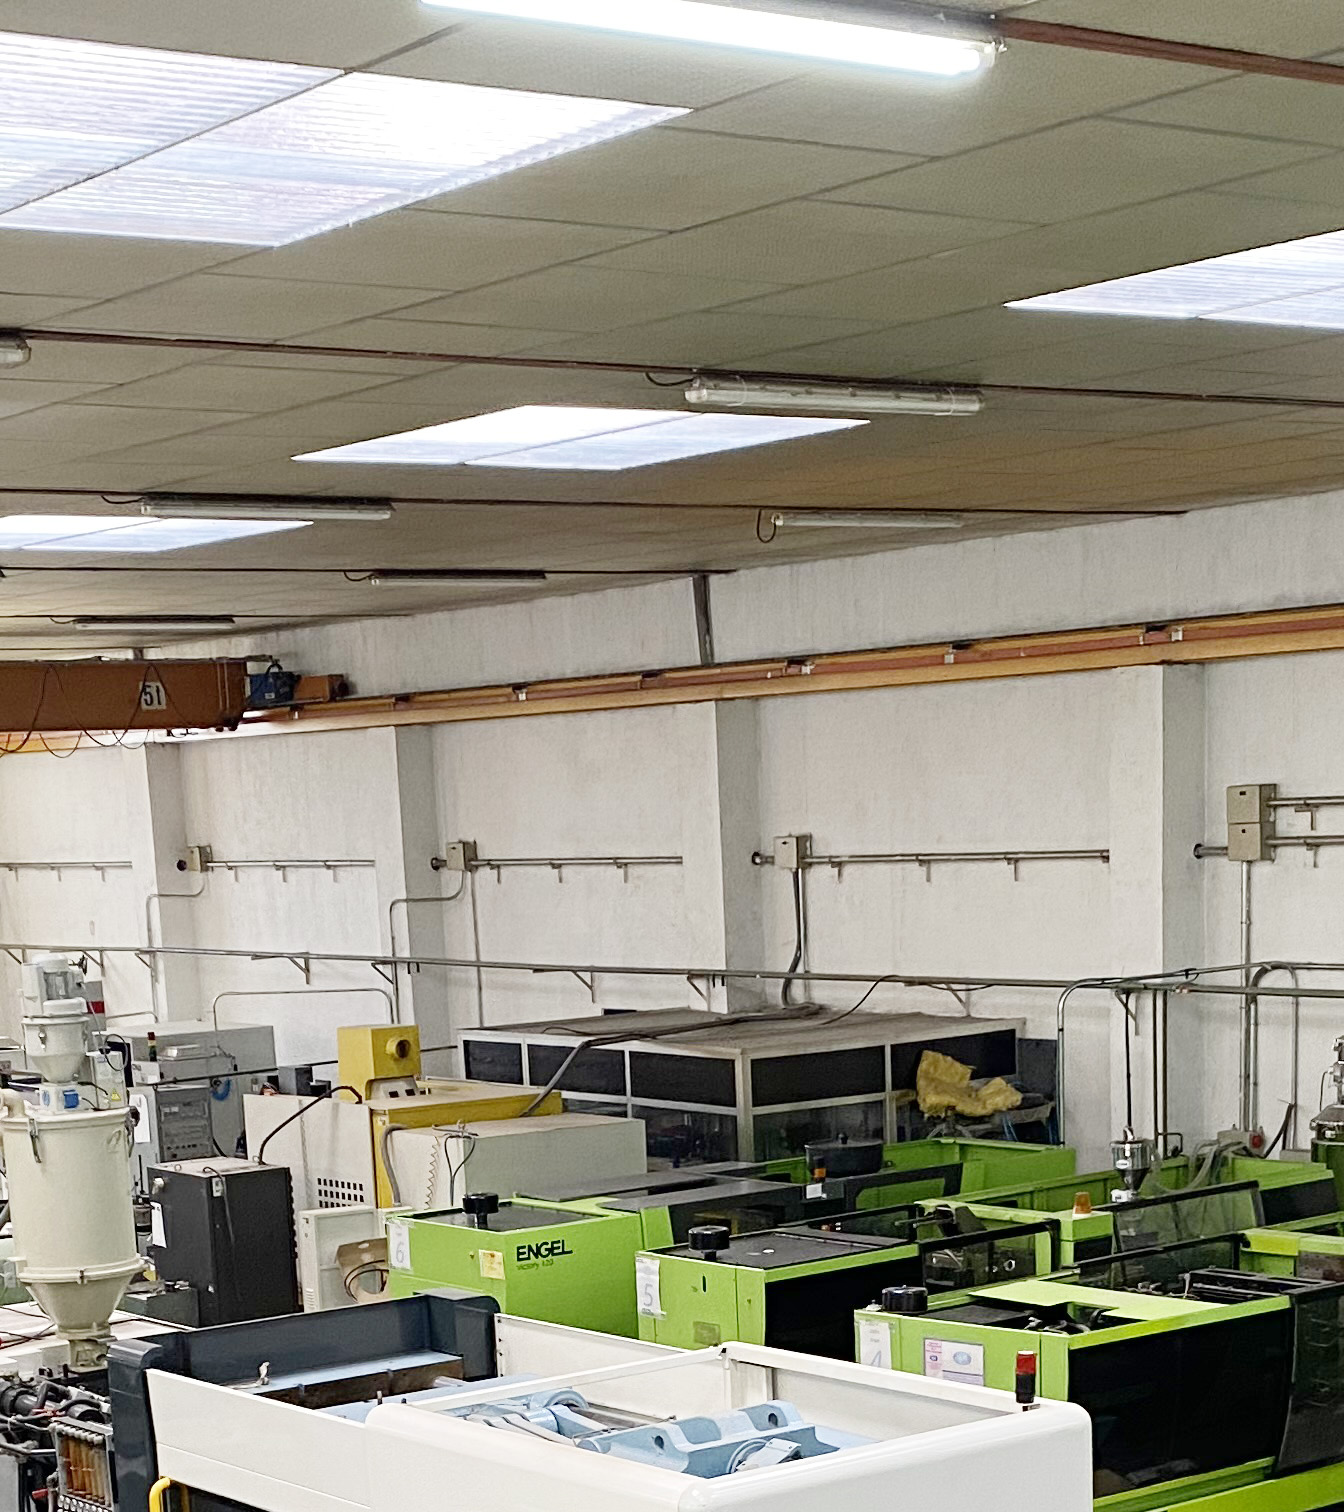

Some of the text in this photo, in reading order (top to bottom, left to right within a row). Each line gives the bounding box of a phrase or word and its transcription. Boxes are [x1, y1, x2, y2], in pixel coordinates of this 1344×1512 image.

[143, 684, 162, 706] 51
[395, 1243, 404, 1264] 6
[516, 1239, 574, 1262] ENGEL
[643, 1283, 653, 1307] 5
